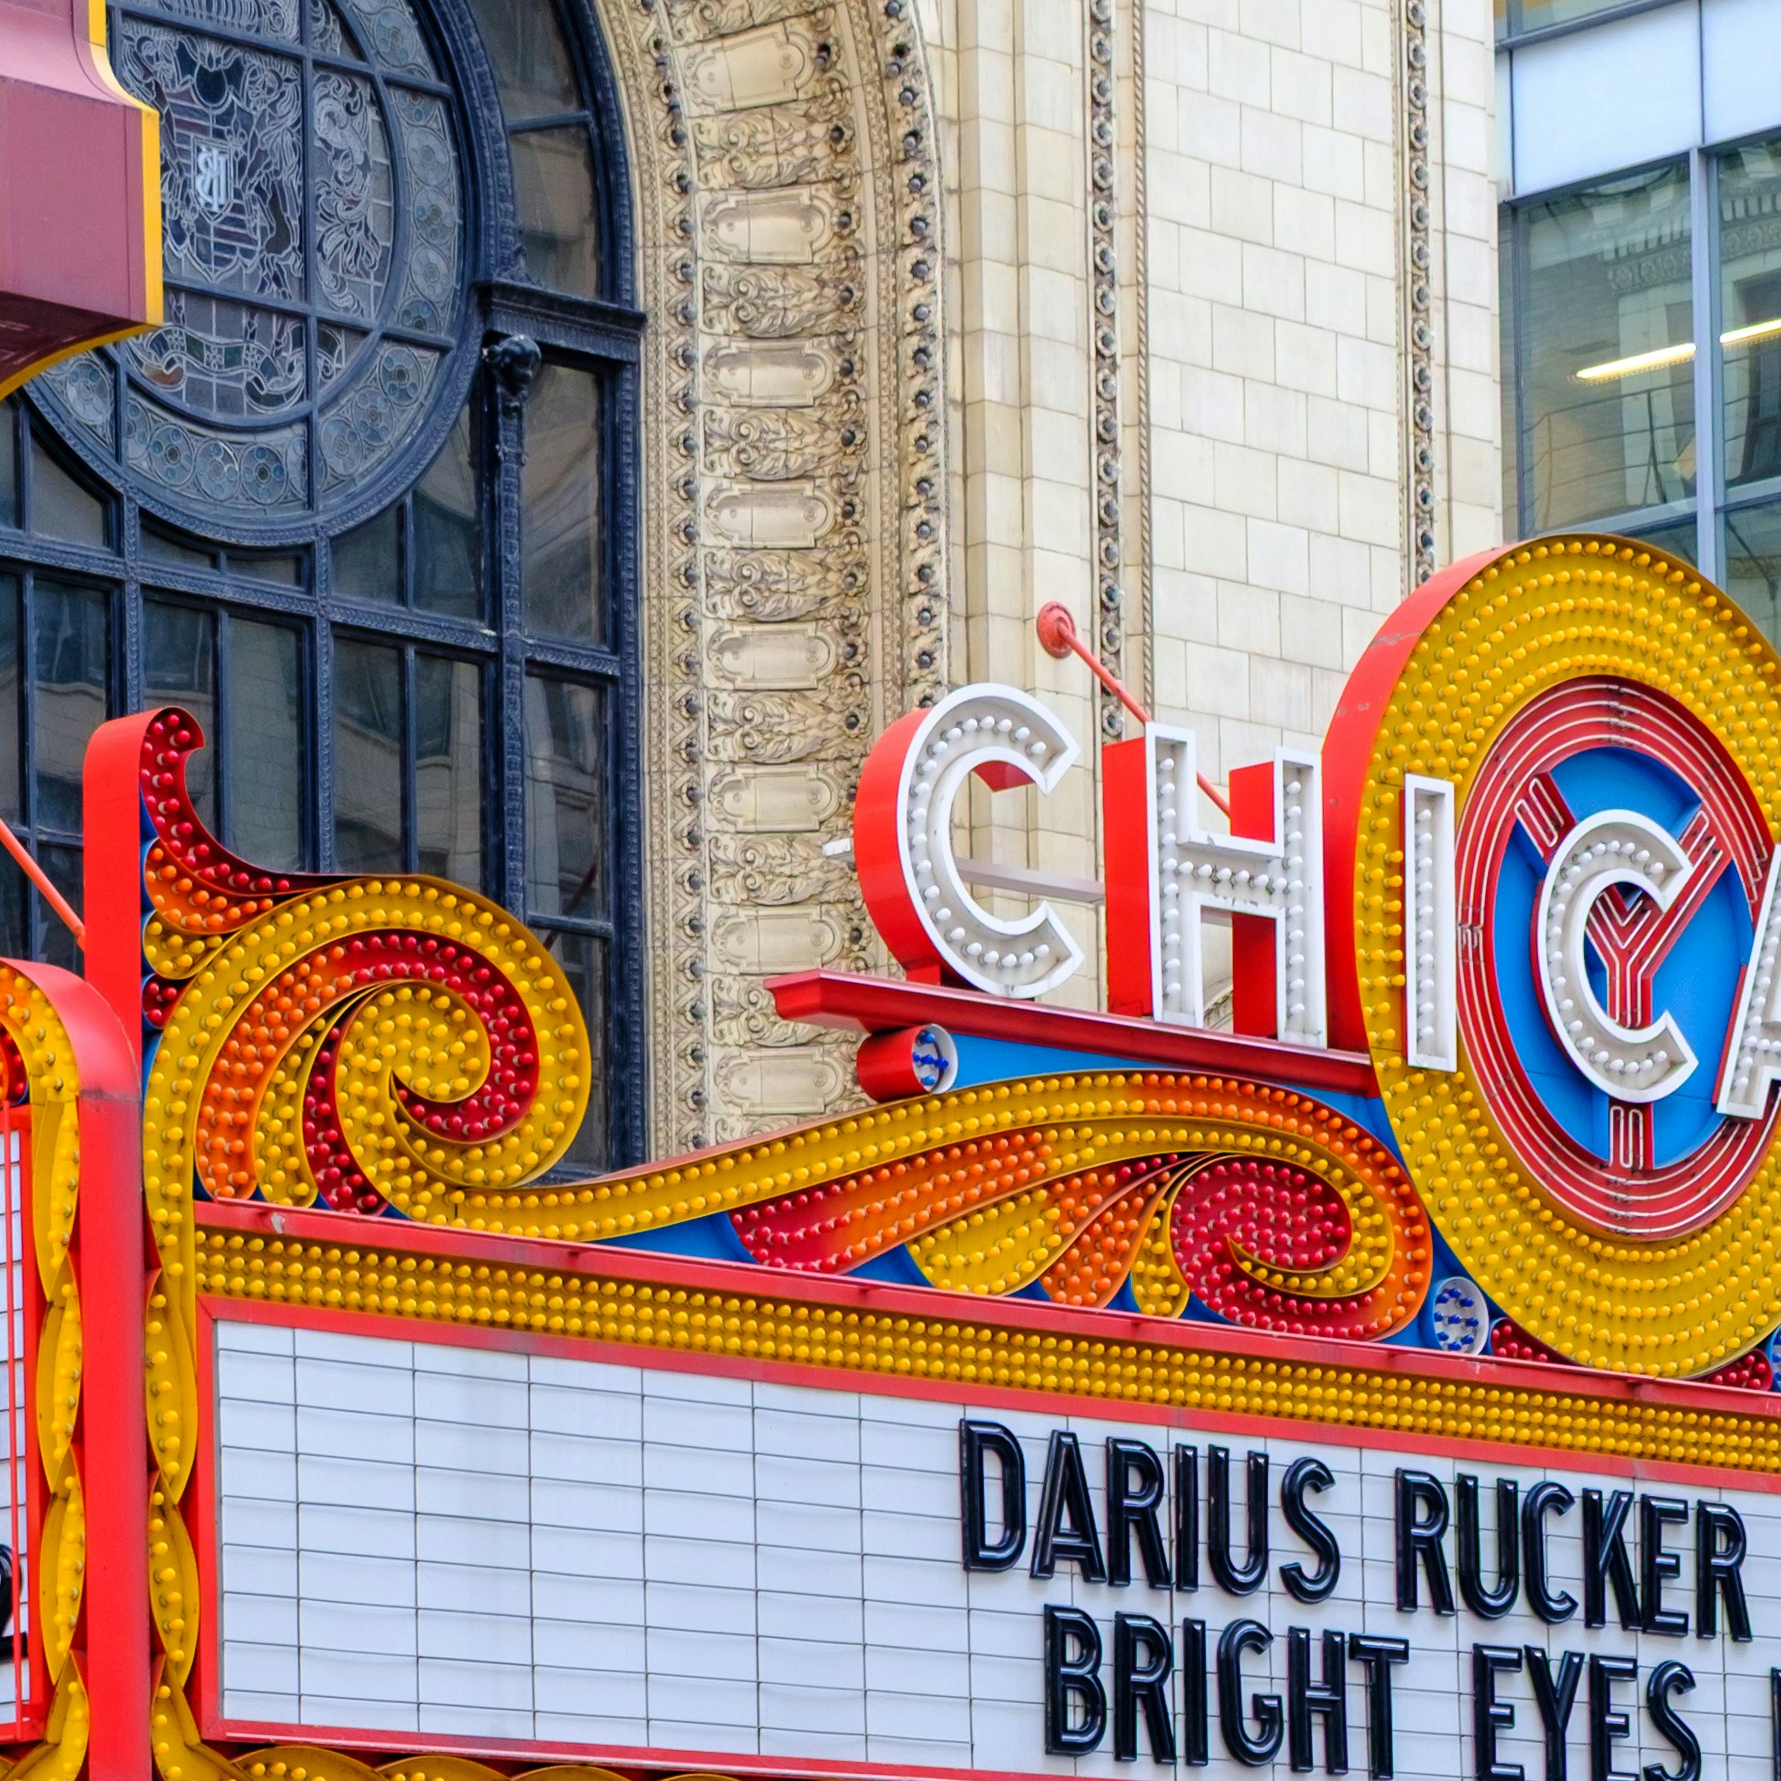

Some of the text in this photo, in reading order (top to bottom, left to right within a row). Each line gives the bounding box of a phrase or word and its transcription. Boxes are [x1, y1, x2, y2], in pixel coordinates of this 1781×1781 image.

[958, 1418, 1340, 1604] DARIUS
[1394, 1467, 1754, 1645] RUCKER
[1043, 1603, 1411, 1781] BRIGHT
